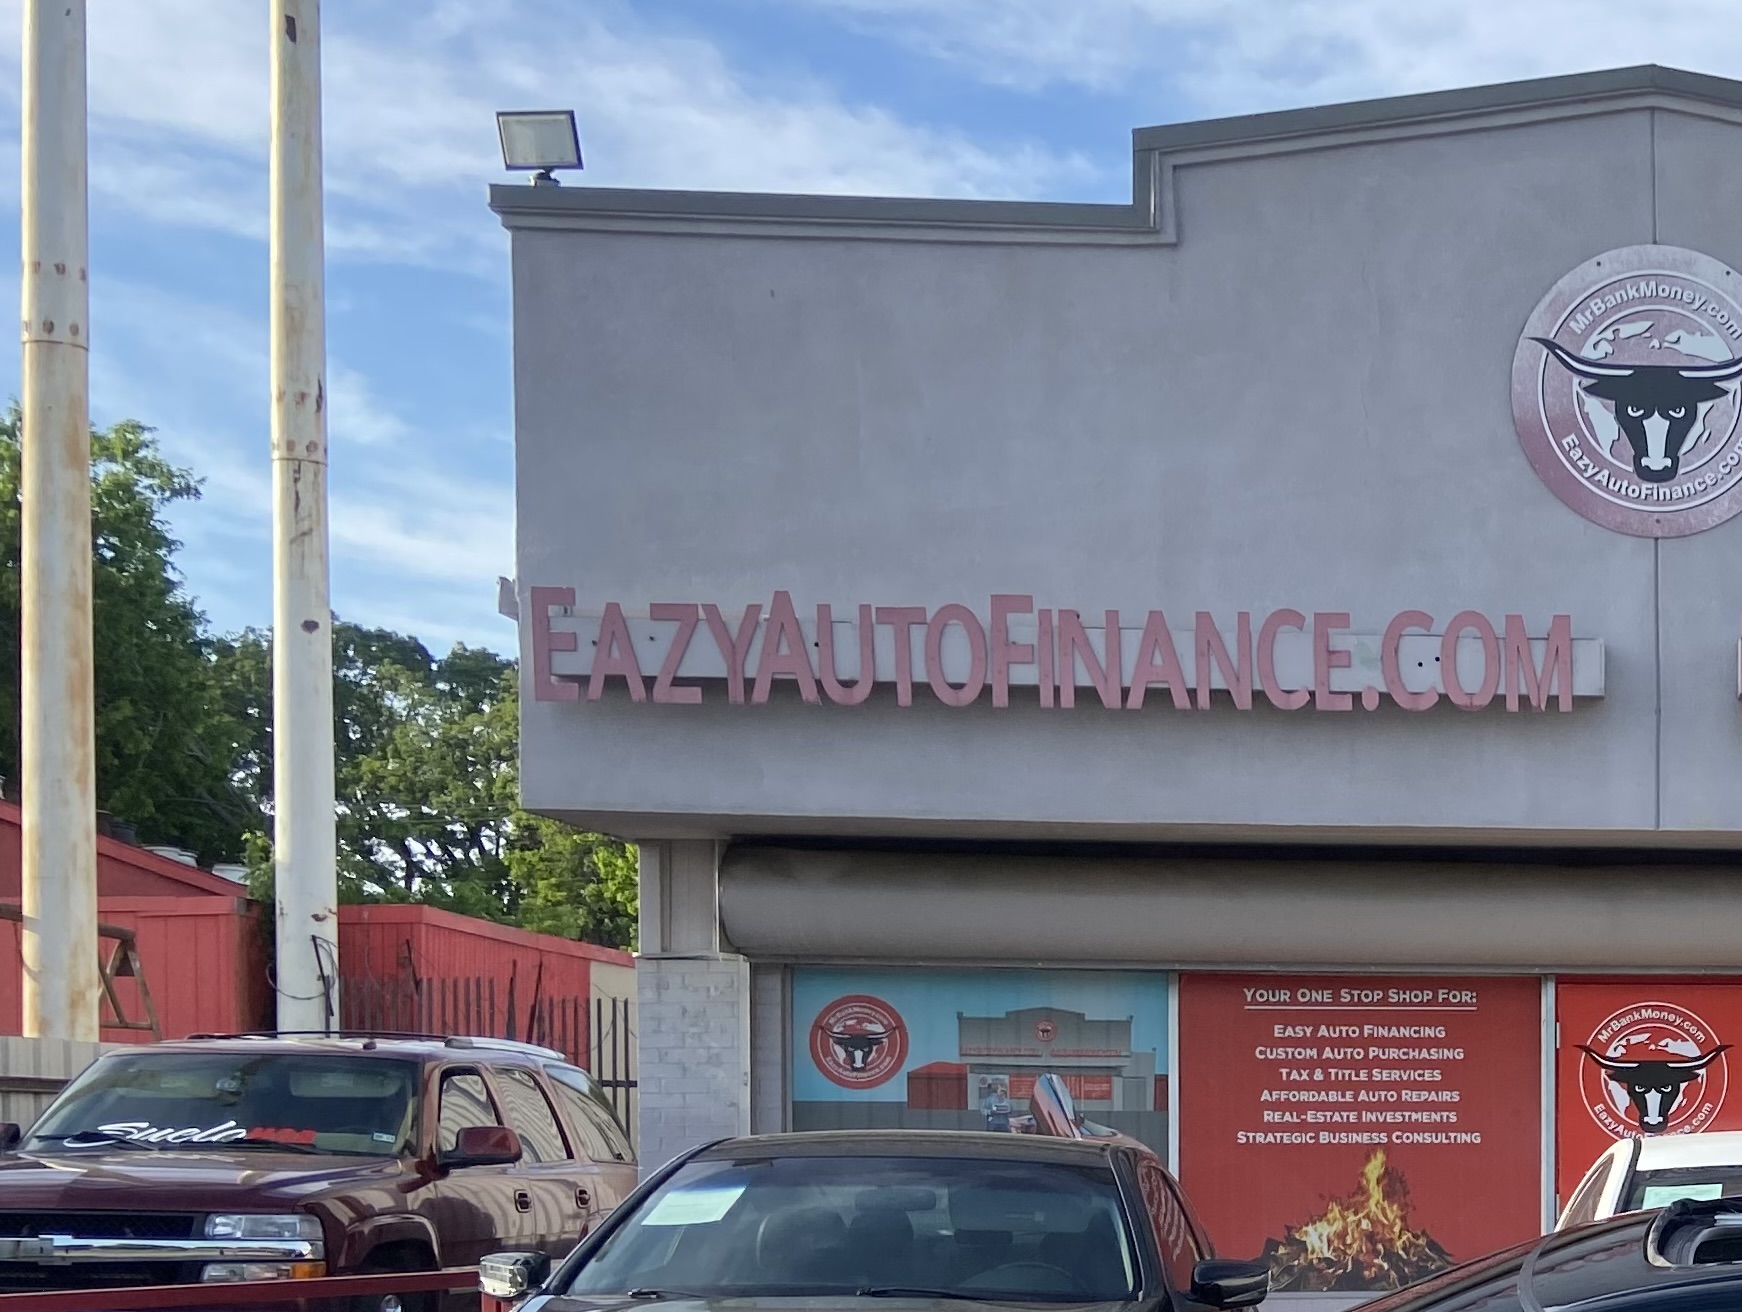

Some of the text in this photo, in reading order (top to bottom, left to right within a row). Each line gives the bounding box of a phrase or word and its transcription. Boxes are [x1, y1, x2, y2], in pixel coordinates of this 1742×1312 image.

[530, 585, 1574, 713] EAZYAUTOFINANCE.COM
[1243, 988, 1477, 1003] YOUR ONE STOP SHOP FOR:
[1273, 1025, 1446, 1038] EASY AUTO FINANCING
[1597, 1008, 1706, 1044] MrBankMoney.com
[1255, 1047, 1465, 1060] CUSTOM AUTO PURCHASING
[1279, 1068, 1442, 1081] TAX & TITLE SERVICES
[1260, 1090, 1460, 1102] AFFORDABLE AUTO REPAIRS
[1263, 1111, 1458, 1123] REAL-ESTATE INVESTMENTS
[1237, 1132, 1482, 1144] STRATEGIC BUSINESS CONSULTING
